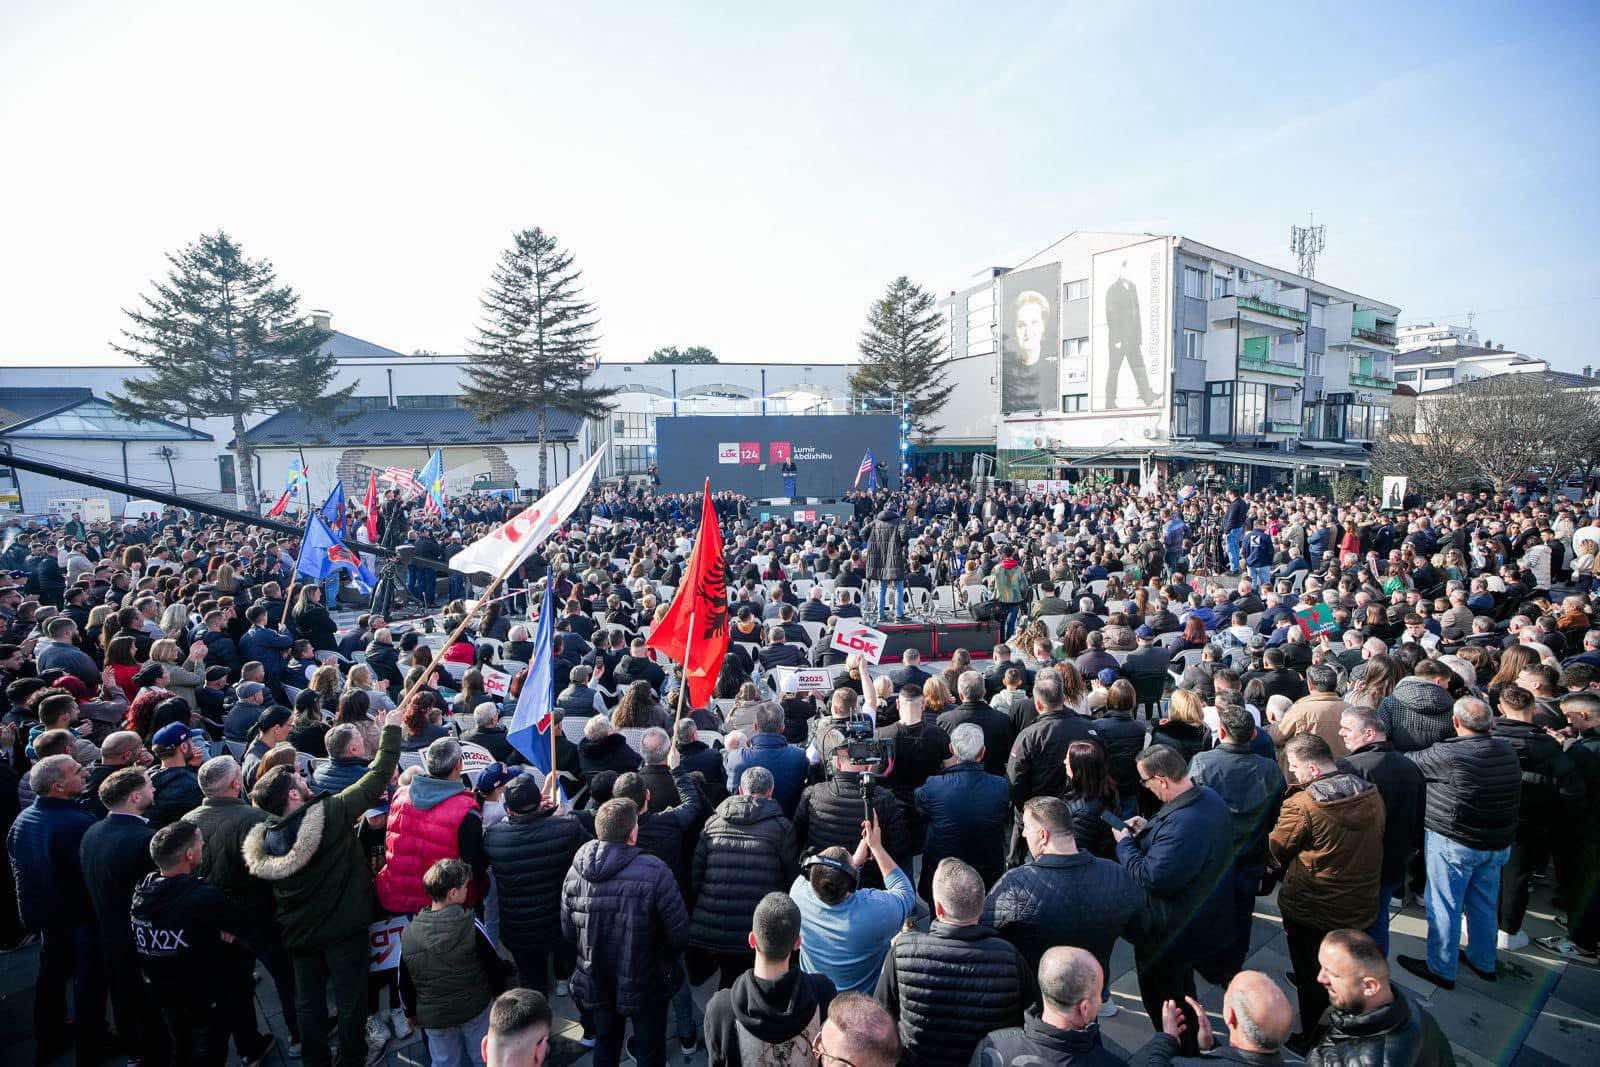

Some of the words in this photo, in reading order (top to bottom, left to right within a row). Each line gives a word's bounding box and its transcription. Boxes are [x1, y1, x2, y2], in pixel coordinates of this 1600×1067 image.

[742, 450, 759, 459] 124
[836, 632, 879, 657] LDK
[485, 680, 505, 692] DK
